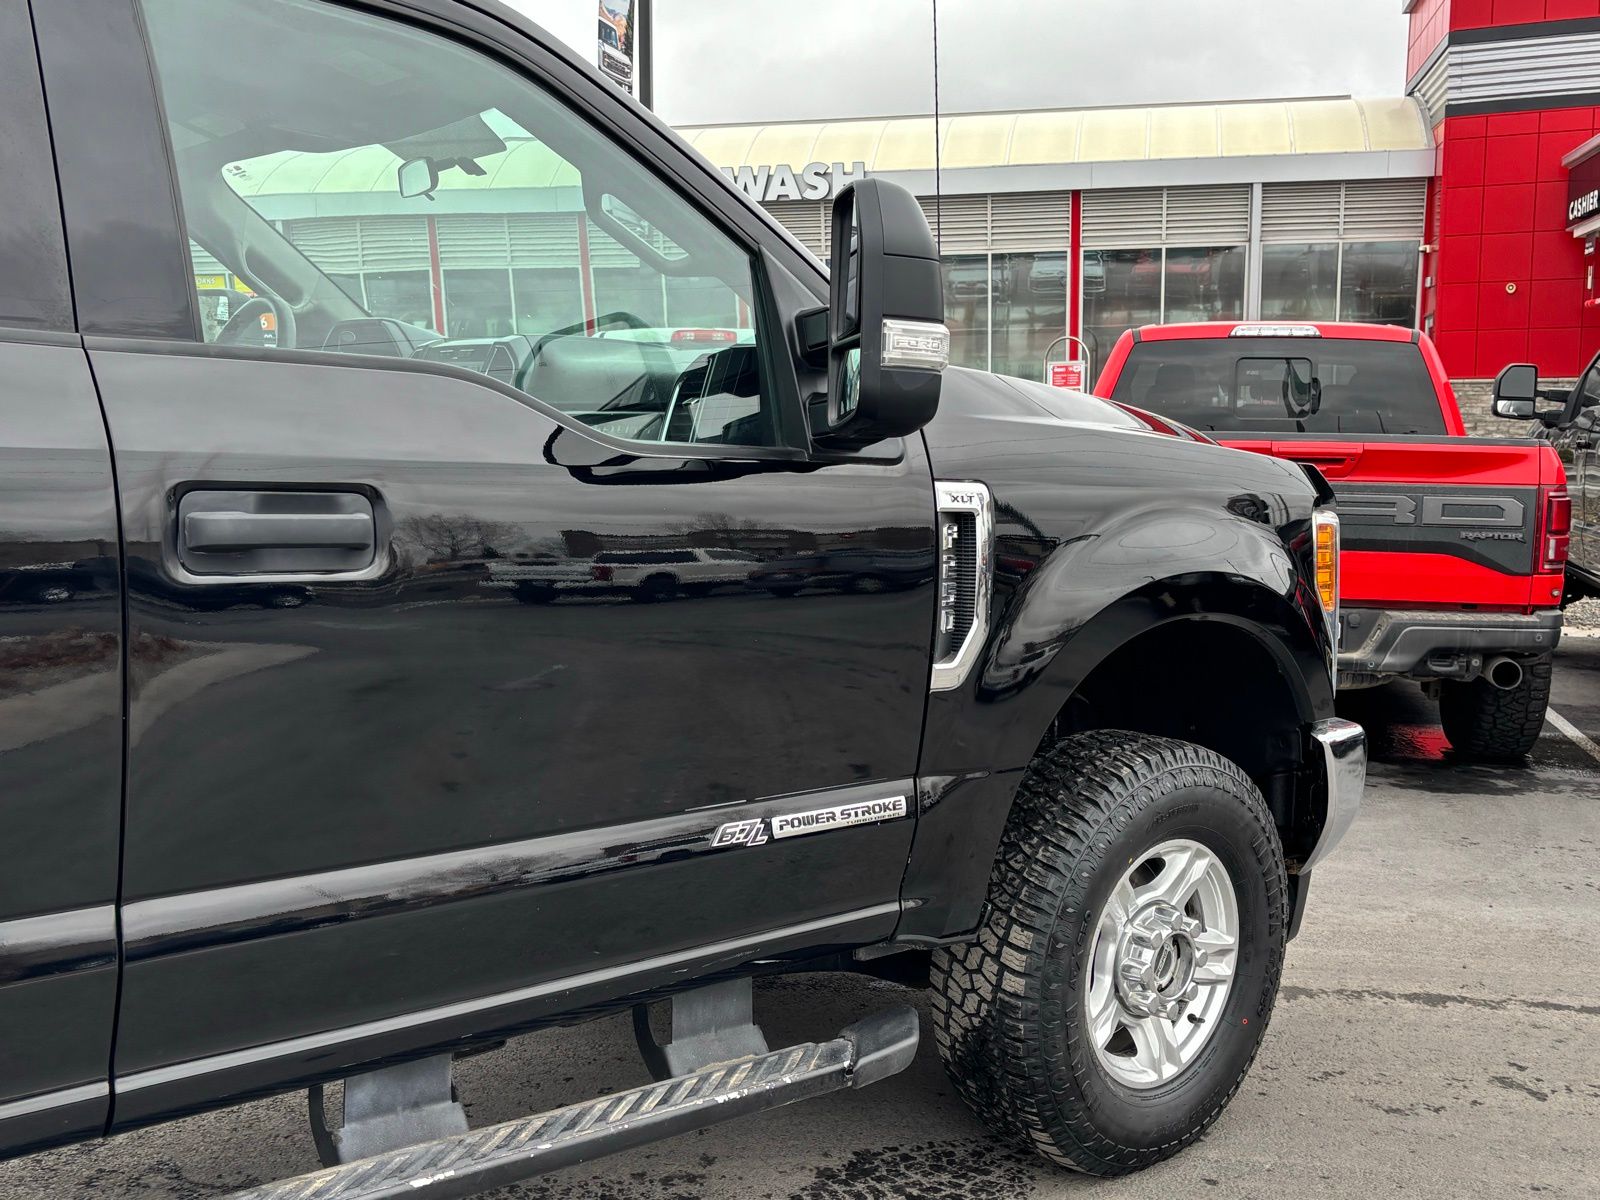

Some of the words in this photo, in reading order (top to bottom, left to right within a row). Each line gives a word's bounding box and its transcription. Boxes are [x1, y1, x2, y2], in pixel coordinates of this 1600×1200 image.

[720, 162, 865, 201] WASH
[1568, 189, 1599, 220] CASHIER
[896, 338, 941, 350] FORD
[951, 495, 975, 503] XLT
[1335, 493, 1525, 528] RD
[1459, 530, 1526, 543] RAPTOR
[779, 811, 837, 831] POWER
[840, 799, 903, 820] STROKE
